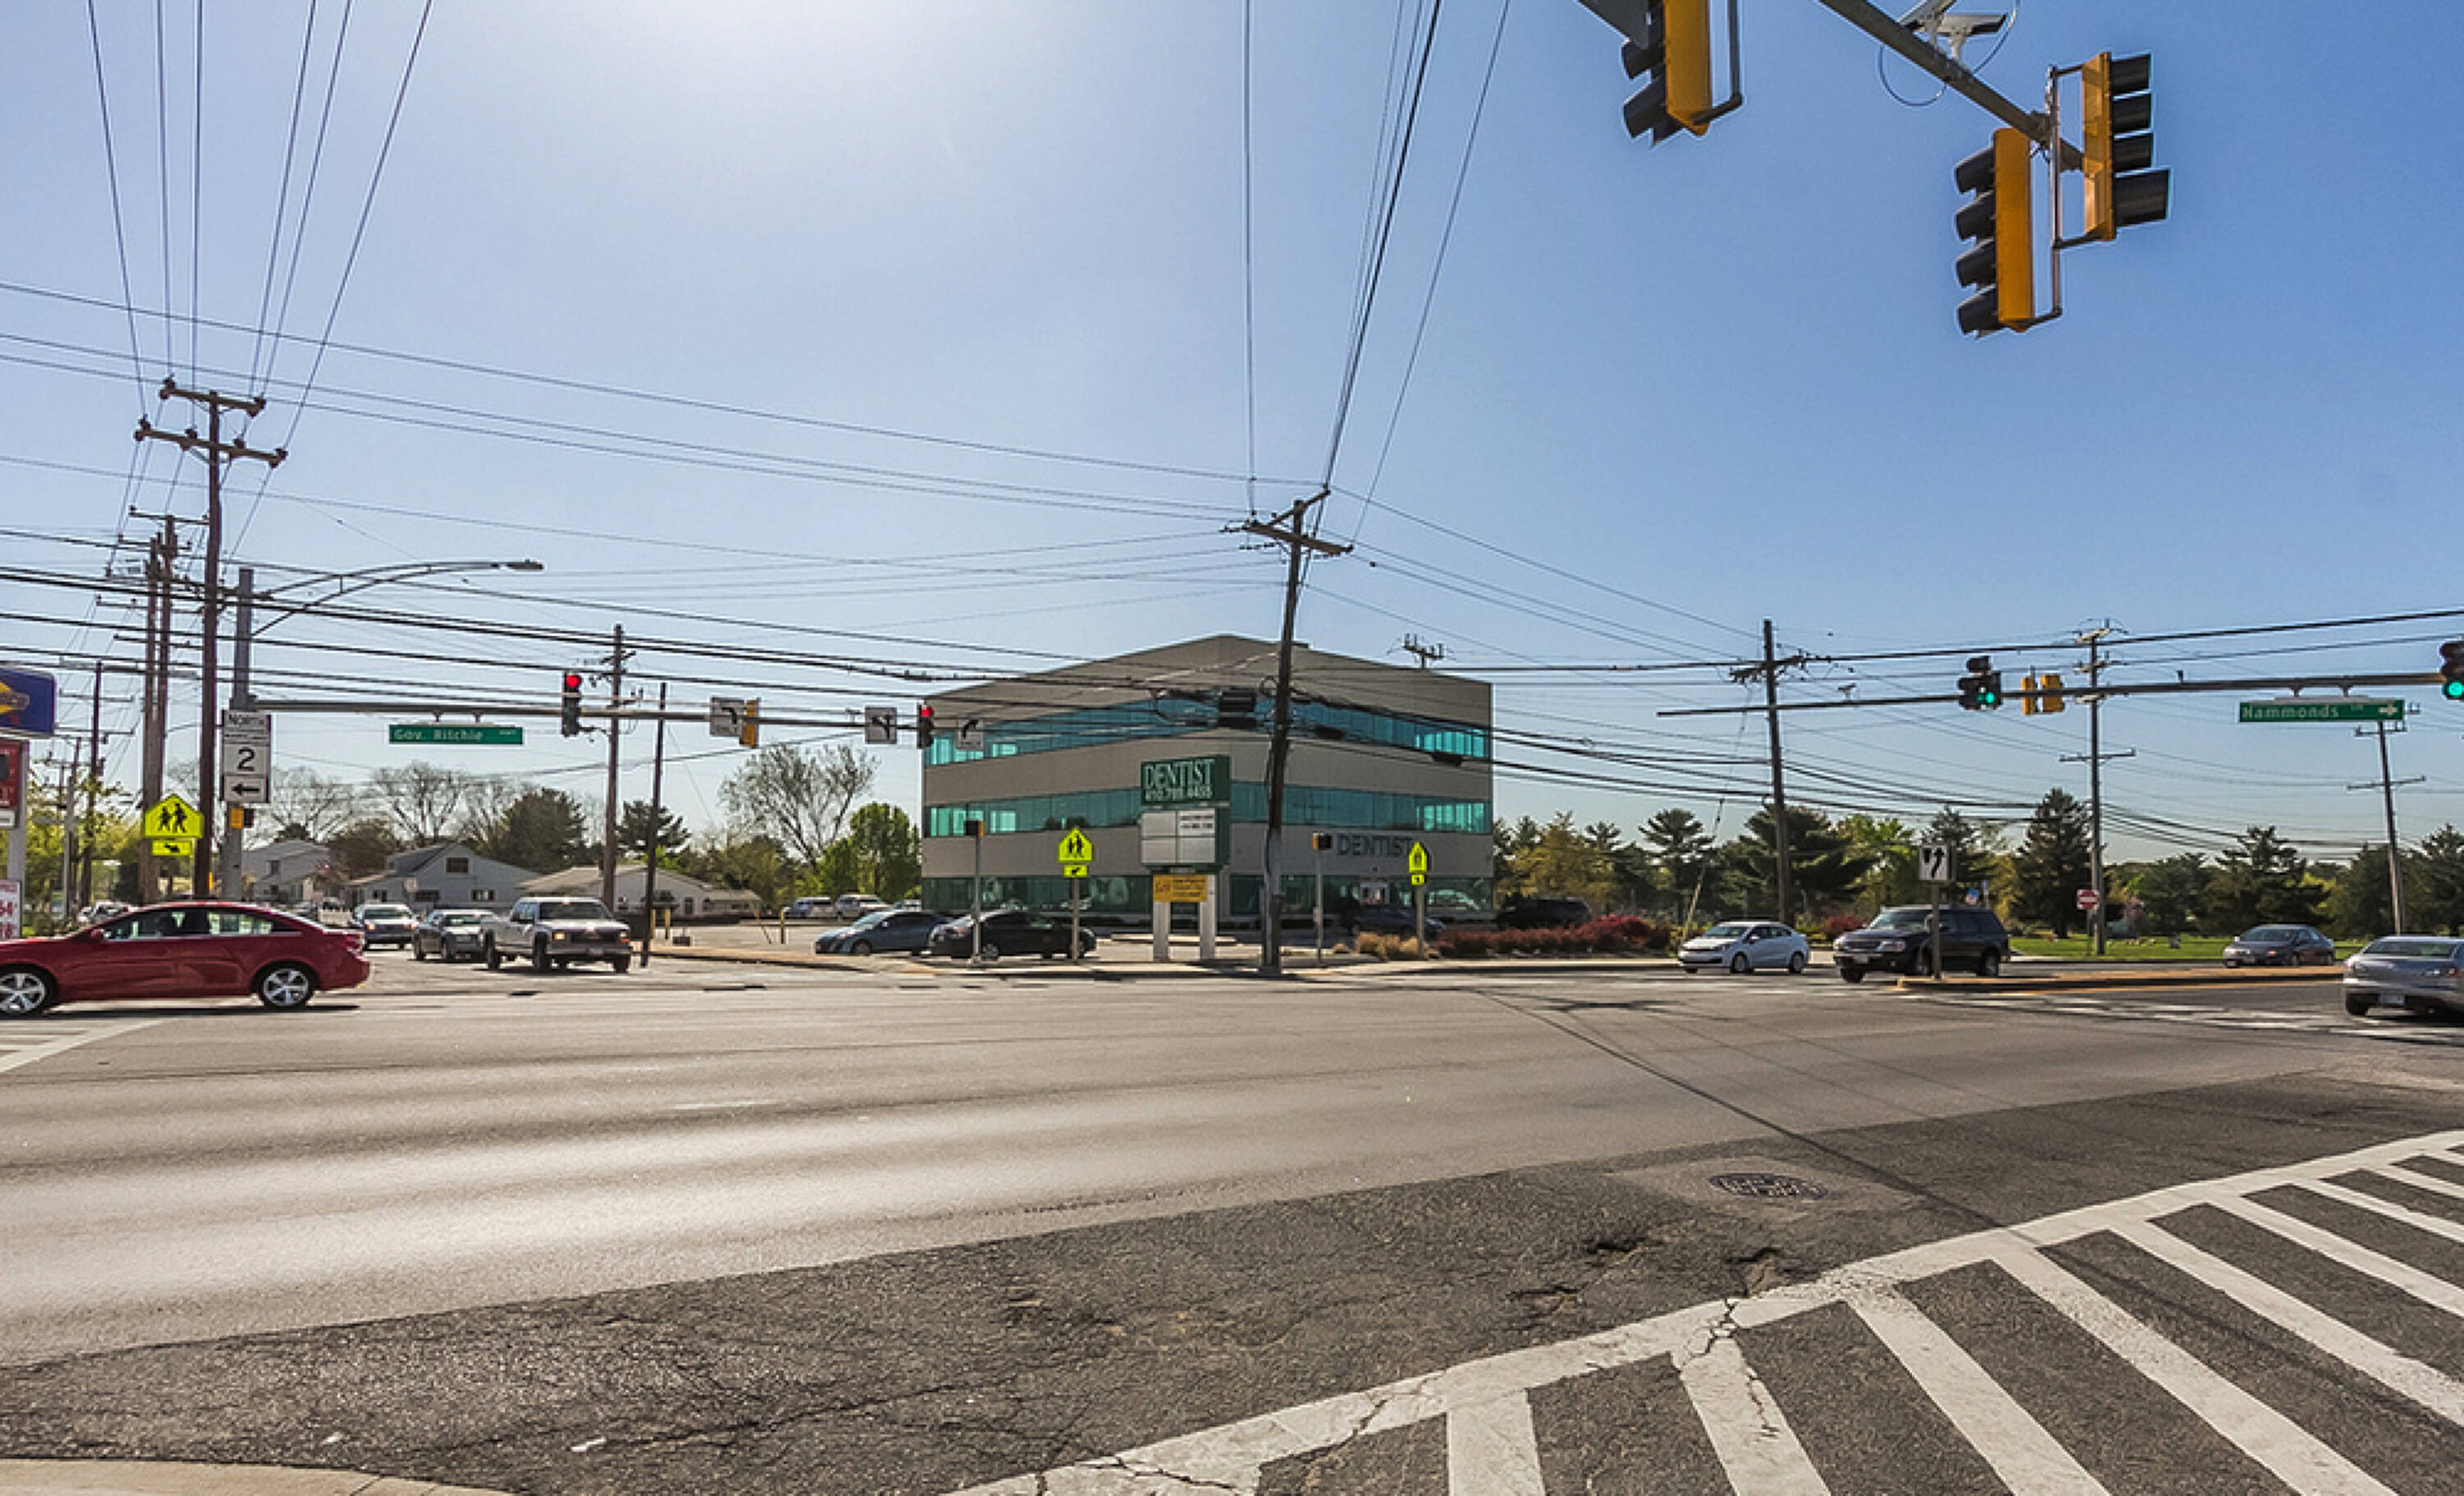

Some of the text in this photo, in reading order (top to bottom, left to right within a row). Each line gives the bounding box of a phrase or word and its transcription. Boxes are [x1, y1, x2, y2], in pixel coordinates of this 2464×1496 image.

[2241, 704, 2340, 718] Hammonds
[237, 746, 255, 771] 2
[1145, 758, 1216, 789] DENTIST
[1339, 835, 1414, 857] DENTIST
